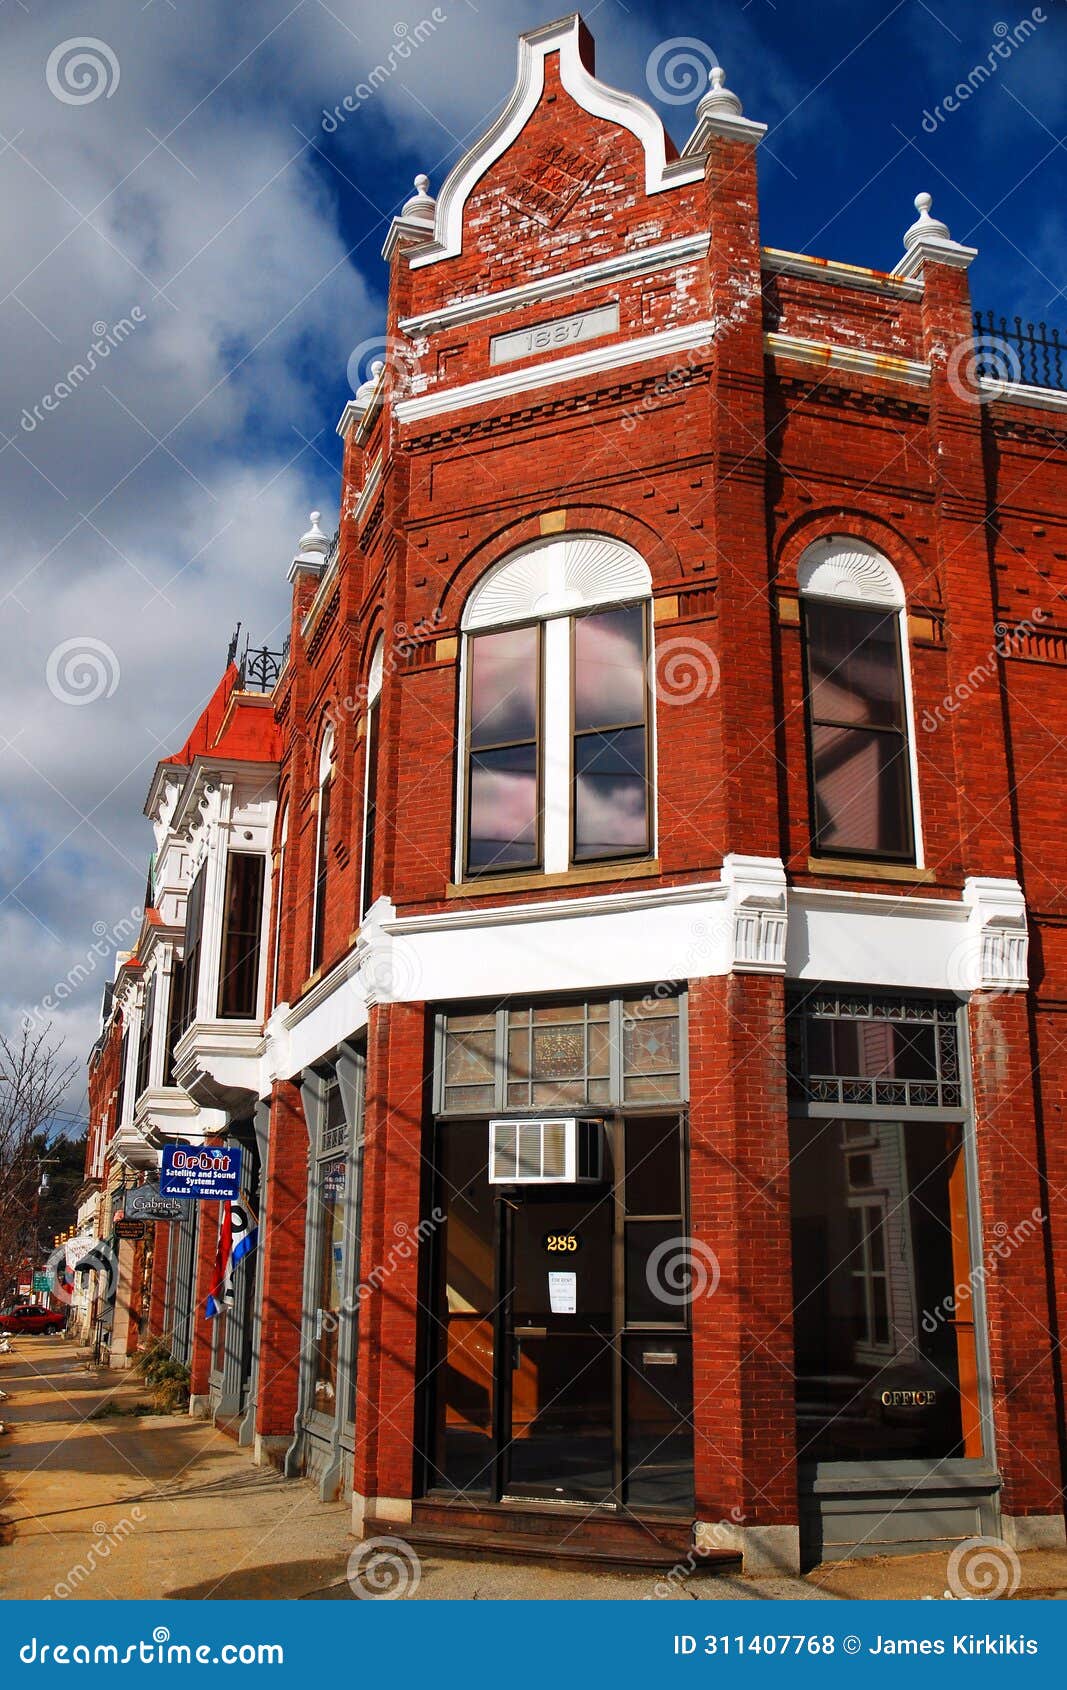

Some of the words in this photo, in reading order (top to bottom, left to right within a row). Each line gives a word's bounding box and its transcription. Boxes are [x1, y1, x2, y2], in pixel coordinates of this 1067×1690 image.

[526, 319, 585, 351] 1887
[172, 1150, 231, 1172] Orbit
[165, 1168, 196, 1178] Satellite
[198, 1170, 213, 1178] and
[213, 1171, 236, 1179] Sound
[185, 1177, 215, 1187] Systems
[200, 1188, 234, 1196] SERVICE
[132, 1196, 181, 1210] Gabriel's
[547, 1235, 578, 1252] 285
[881, 1391, 937, 1406] OFFICE
